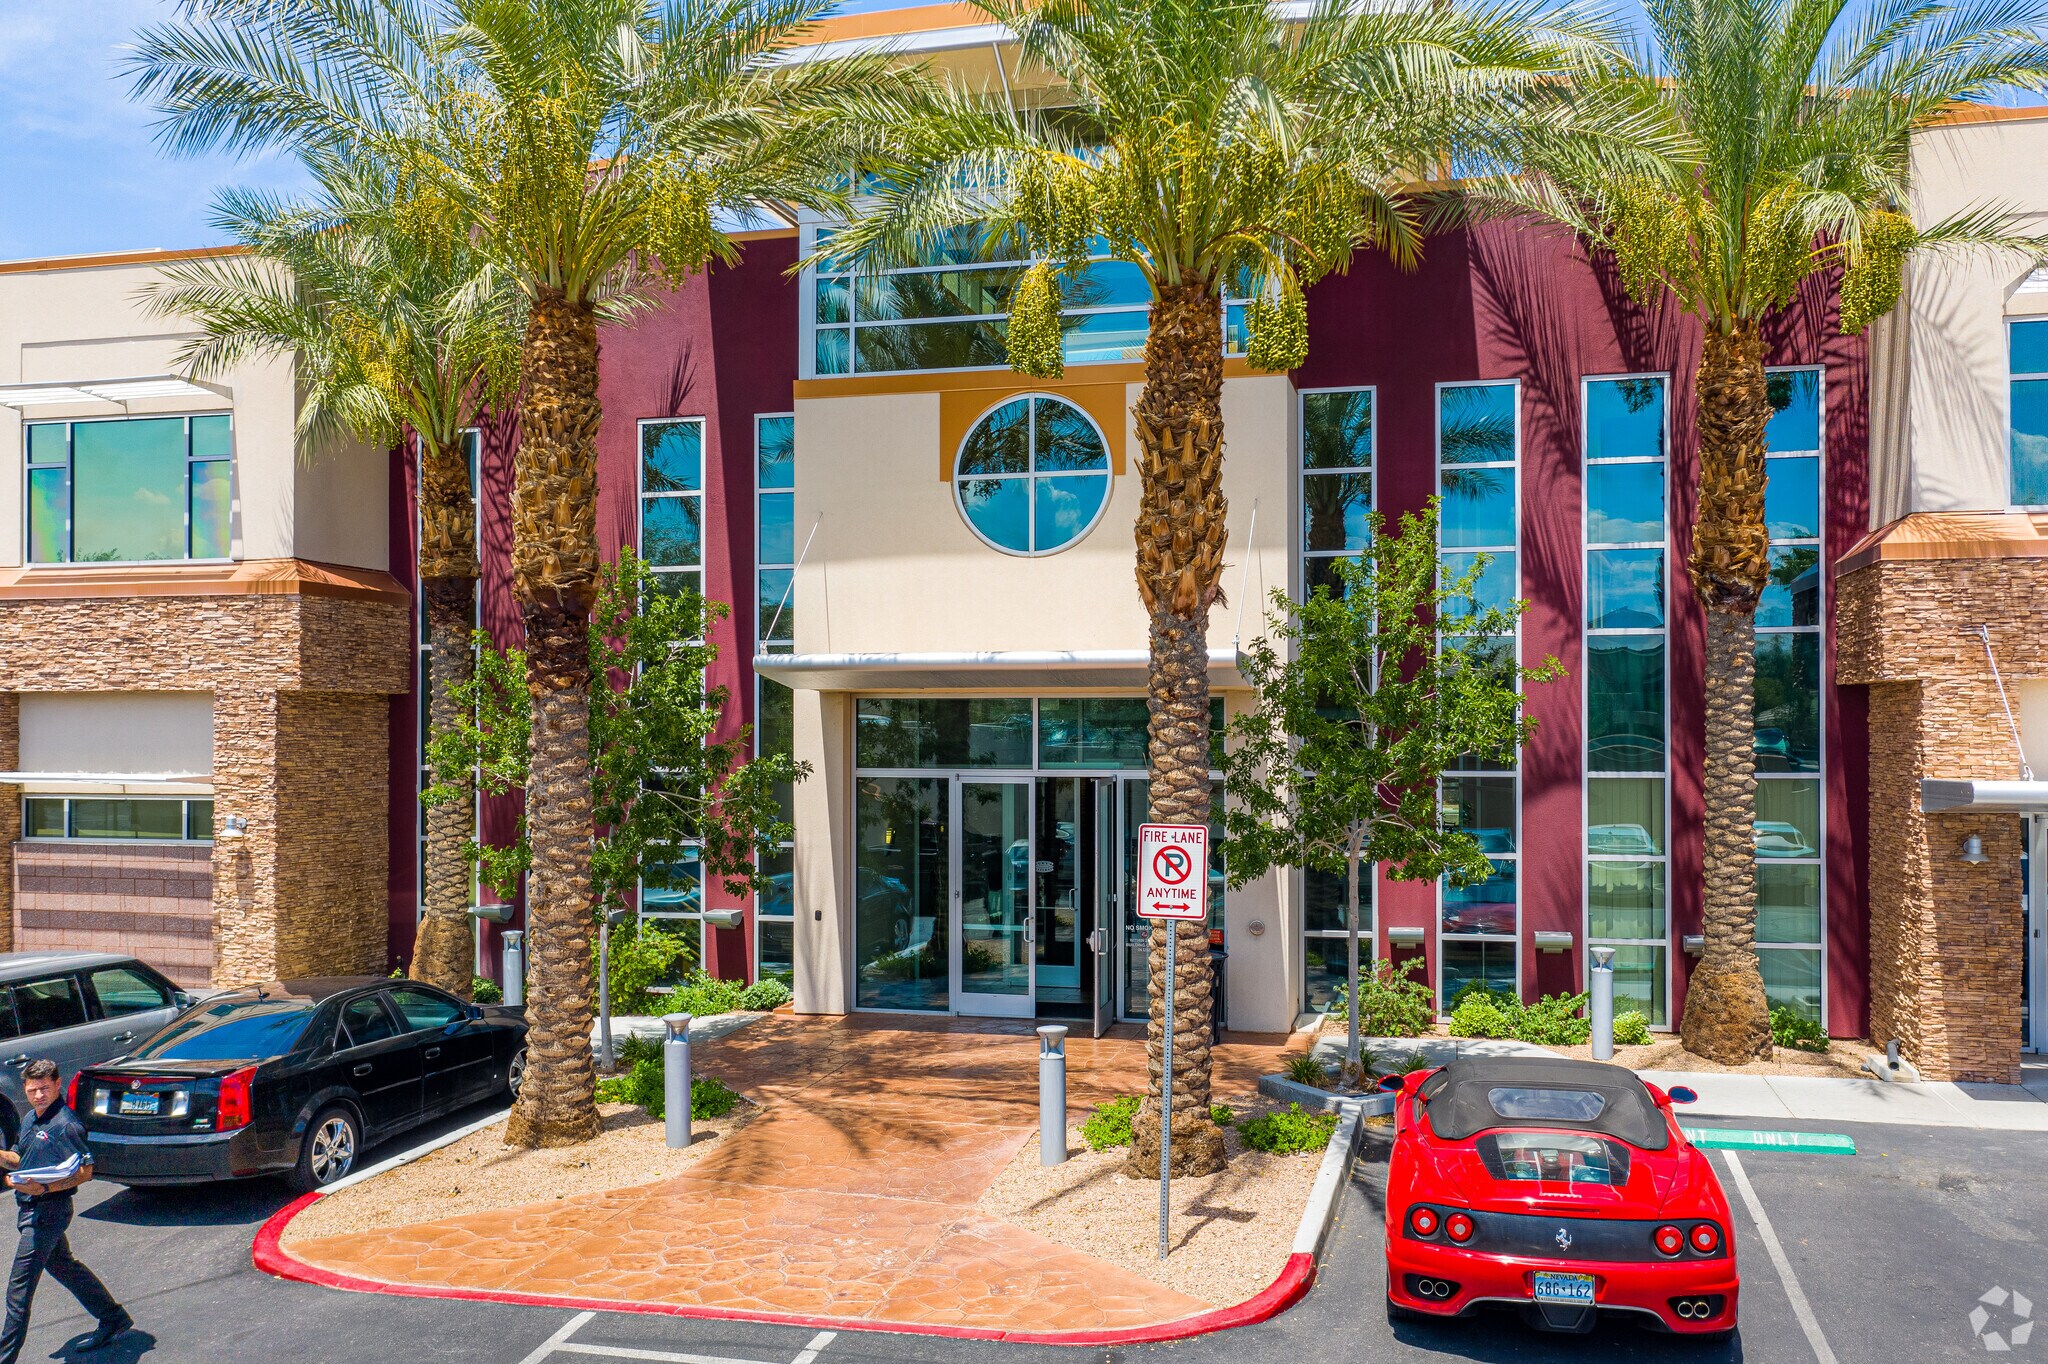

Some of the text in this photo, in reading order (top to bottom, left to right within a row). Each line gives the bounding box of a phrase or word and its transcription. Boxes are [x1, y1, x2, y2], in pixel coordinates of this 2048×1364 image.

[1144, 830, 1203, 844] FIRE LANE
[1146, 887, 1197, 900] ANYTIME
[1753, 1131, 1800, 1146] ONLY
[1550, 1273, 1578, 1281] NEVADA
